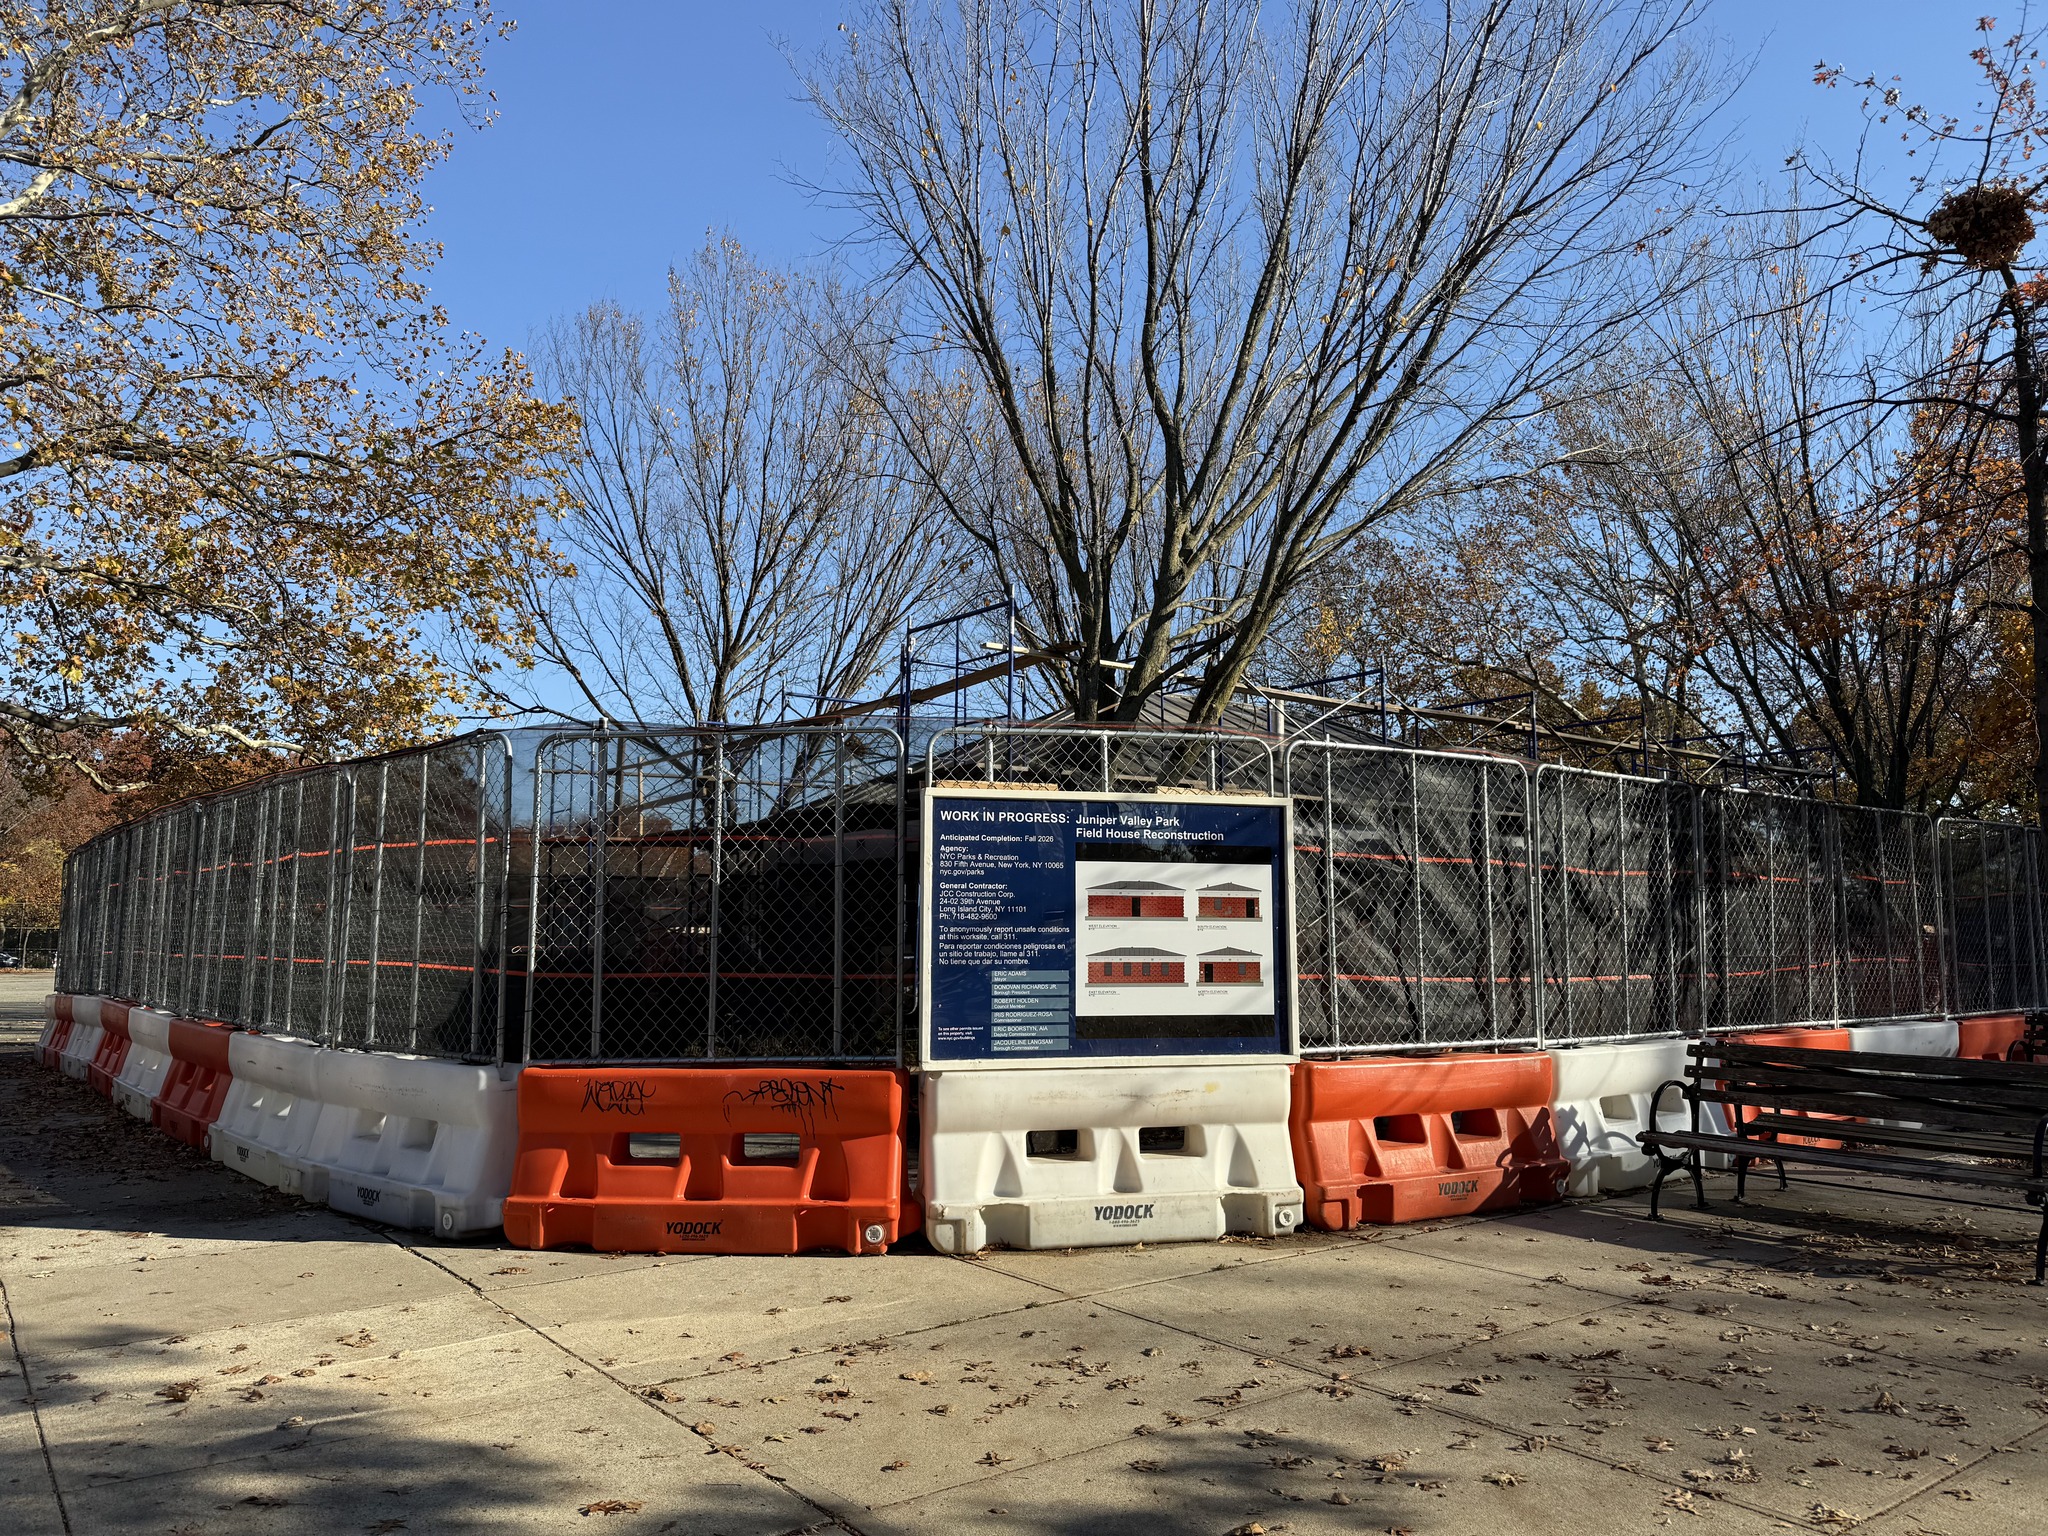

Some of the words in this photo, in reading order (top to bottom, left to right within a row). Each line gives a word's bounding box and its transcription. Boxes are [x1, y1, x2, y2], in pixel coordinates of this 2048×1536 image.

[940, 810, 979, 821] WORK
[983, 811, 994, 821] IN
[999, 812, 1070, 823] PROGRESS:
[1076, 815, 1117, 826] Juniper
[1120, 815, 1152, 827] Valley
[1156, 816, 1180, 826] Park
[940, 834, 979, 842] Anticipated
[981, 835, 1022, 843] Completion:
[1076, 828, 1102, 838] Field
[1106, 828, 1140, 839] House
[1143, 829, 1224, 841] Reconstruction
[940, 845, 968, 853] Agency:
[998, 891, 1015, 899] Corp.
[950, 926, 992, 934] anonymously
[994, 926, 1013, 934] report
[1023, 943, 1055, 951] peligrosas
[1438, 1180, 1478, 1196] YODOCK
[1094, 1204, 1154, 1220] YODOCK
[666, 1222, 721, 1234] YODOCK
